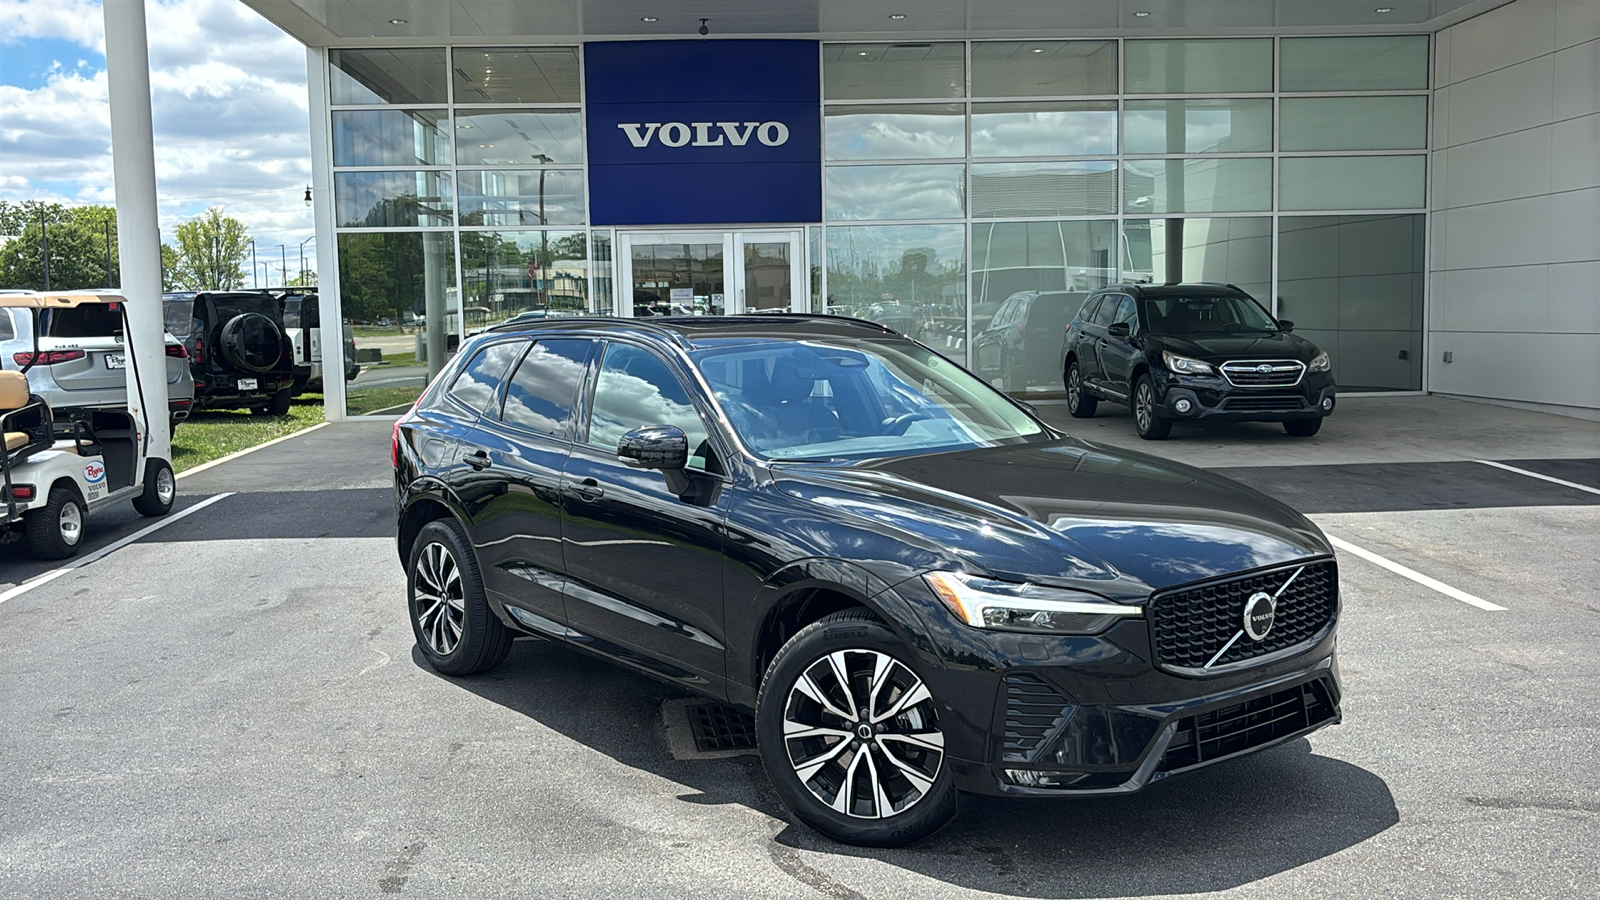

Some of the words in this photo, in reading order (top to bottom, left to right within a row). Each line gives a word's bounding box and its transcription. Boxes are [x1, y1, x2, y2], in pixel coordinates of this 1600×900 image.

[617, 121, 789, 148] VOLVO
[87, 481, 106, 492] VOLVO
[1252, 612, 1273, 622] VOLVO
[823, 627, 869, 641] PIRELLI
